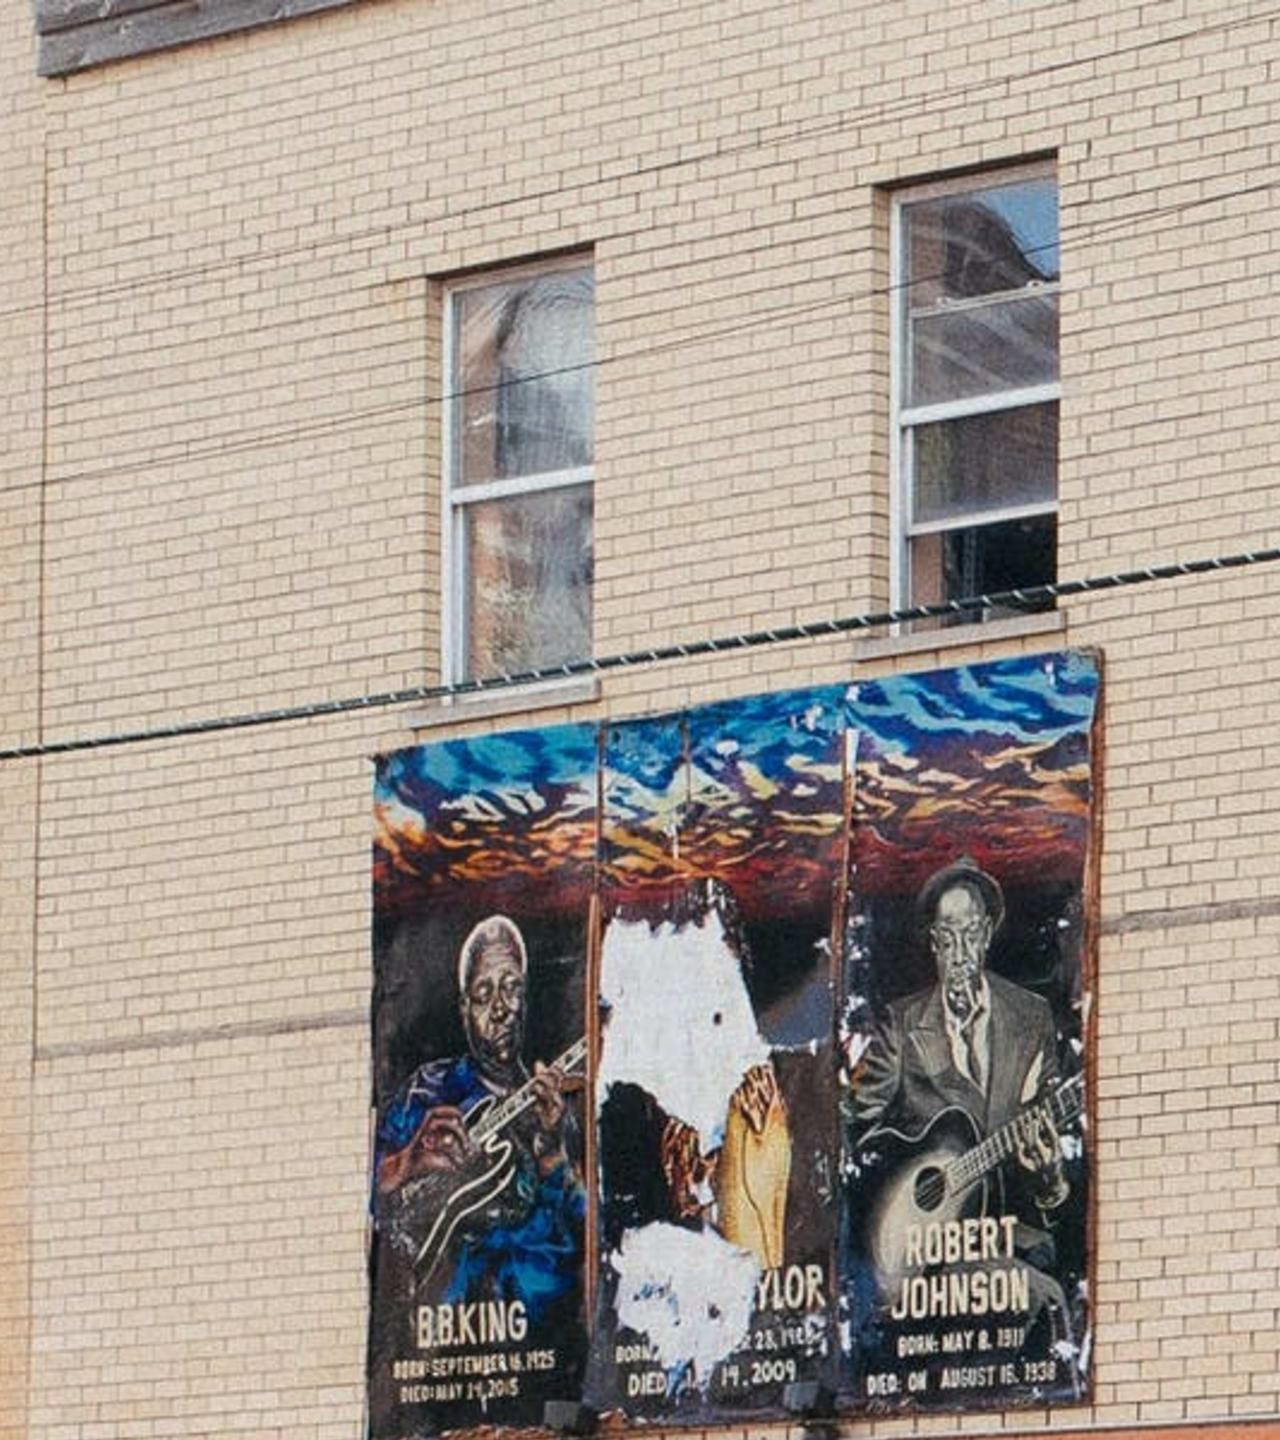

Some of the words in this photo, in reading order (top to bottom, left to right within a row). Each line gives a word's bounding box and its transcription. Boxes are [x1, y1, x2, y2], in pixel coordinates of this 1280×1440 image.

[905, 1214, 1018, 1267] ROBERT
[890, 1267, 1030, 1320] JOHNSON
[942, 1330, 974, 1352] MAY
[908, 1369, 928, 1392] ON
[939, 1364, 996, 1389] AUGUST
